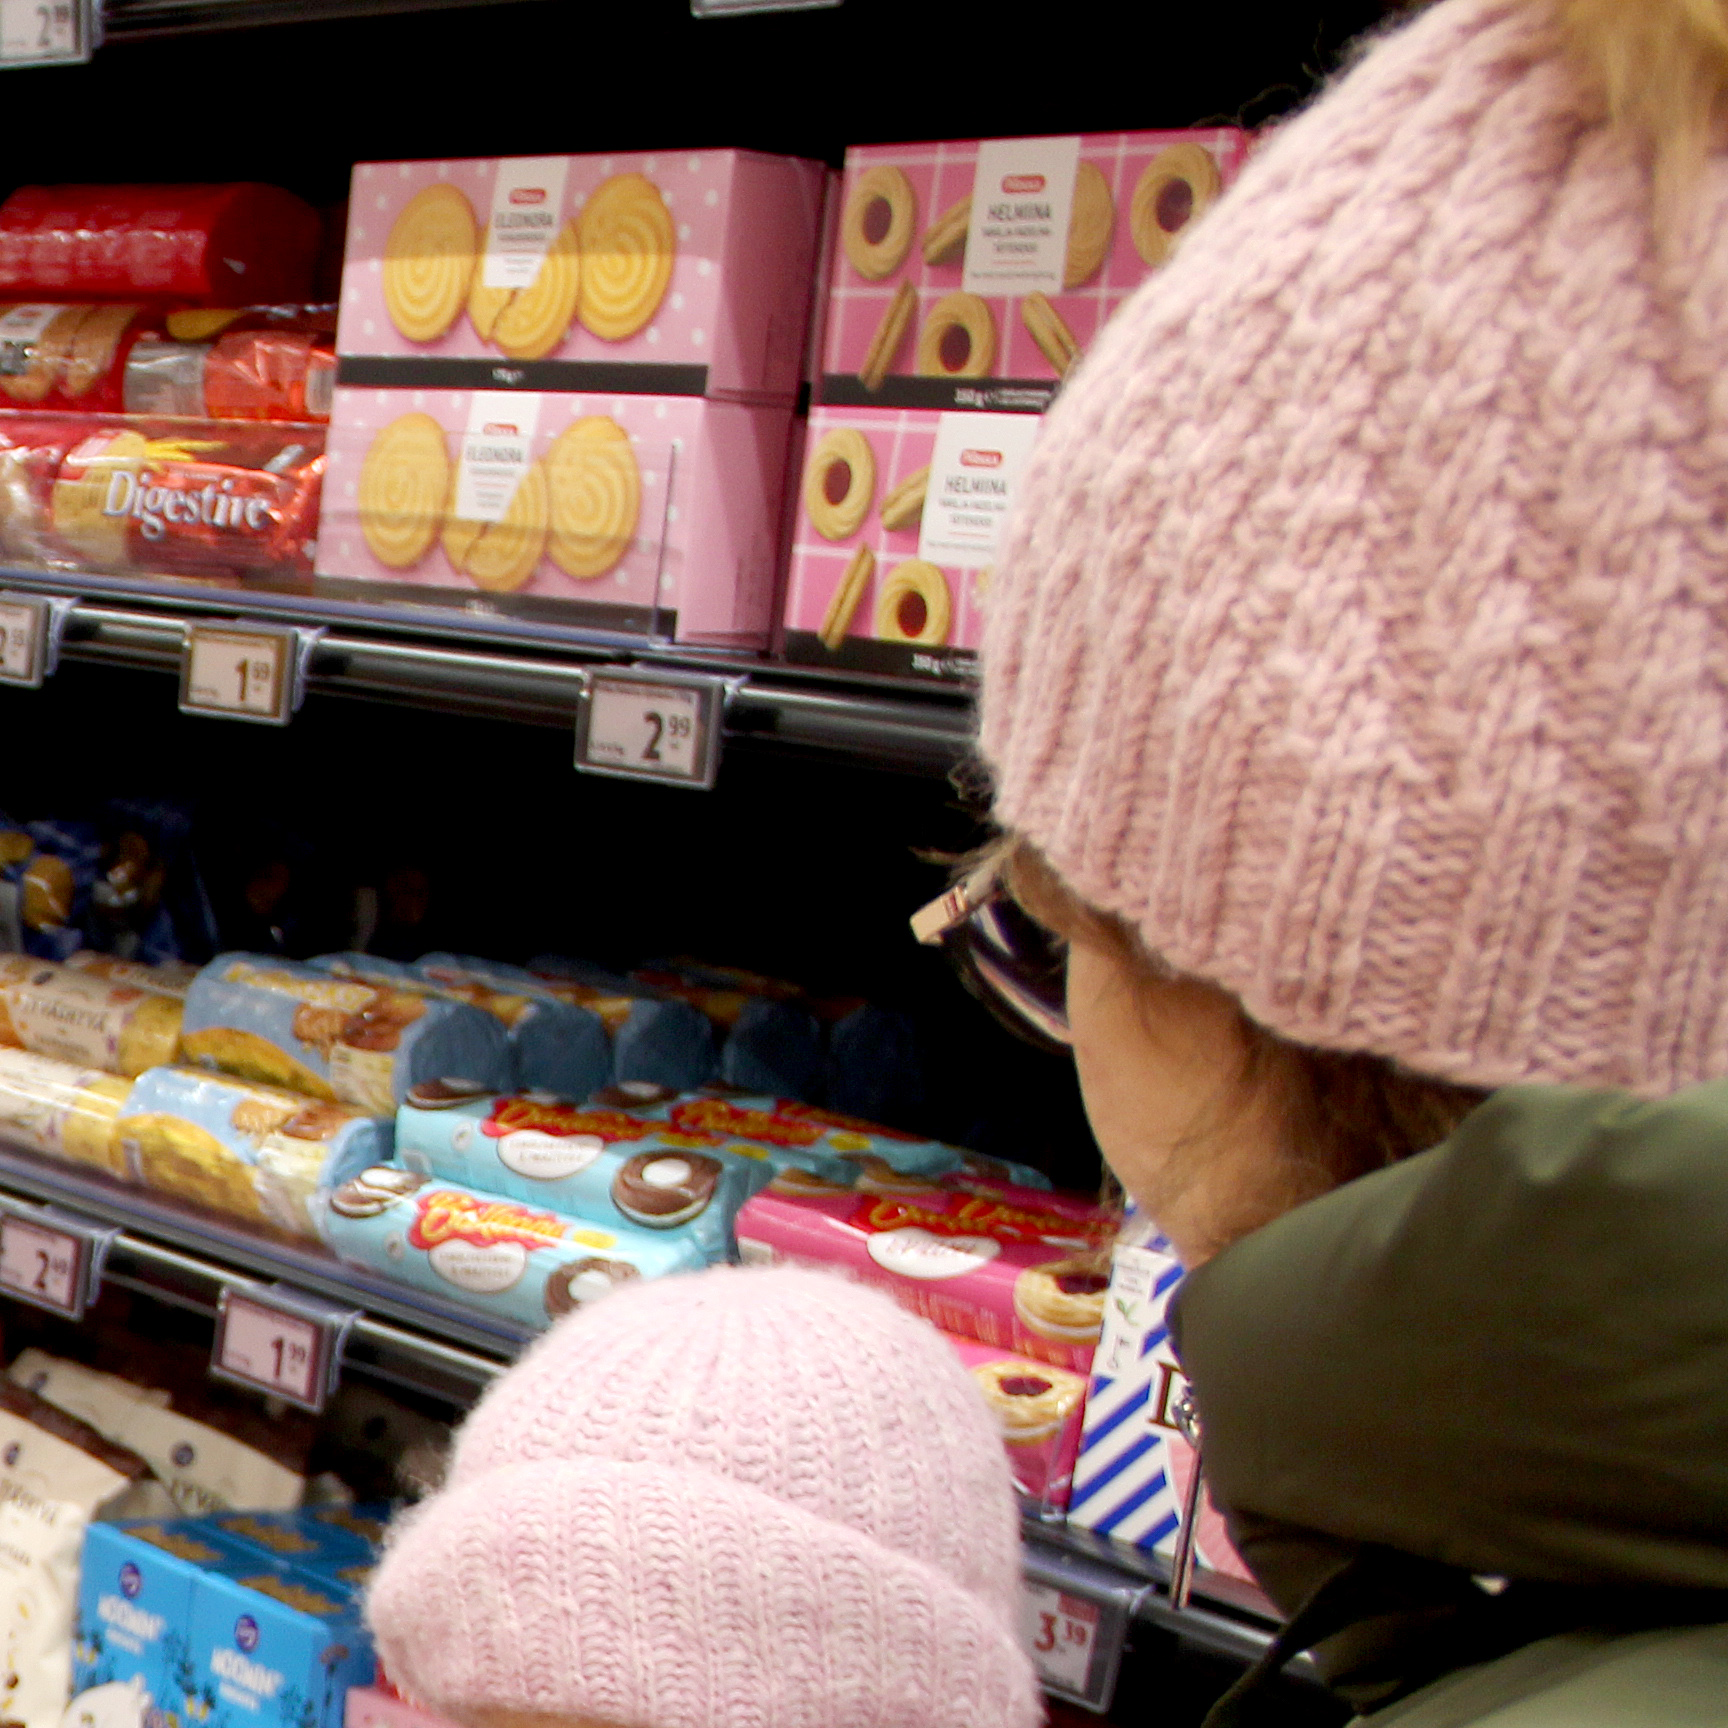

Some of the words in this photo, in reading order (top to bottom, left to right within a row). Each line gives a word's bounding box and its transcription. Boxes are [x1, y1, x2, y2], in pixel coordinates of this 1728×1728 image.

[102, 469, 277, 541] Digestive
[642, 711, 663, 760] 2
[1034, 1610, 1058, 1653] 3
